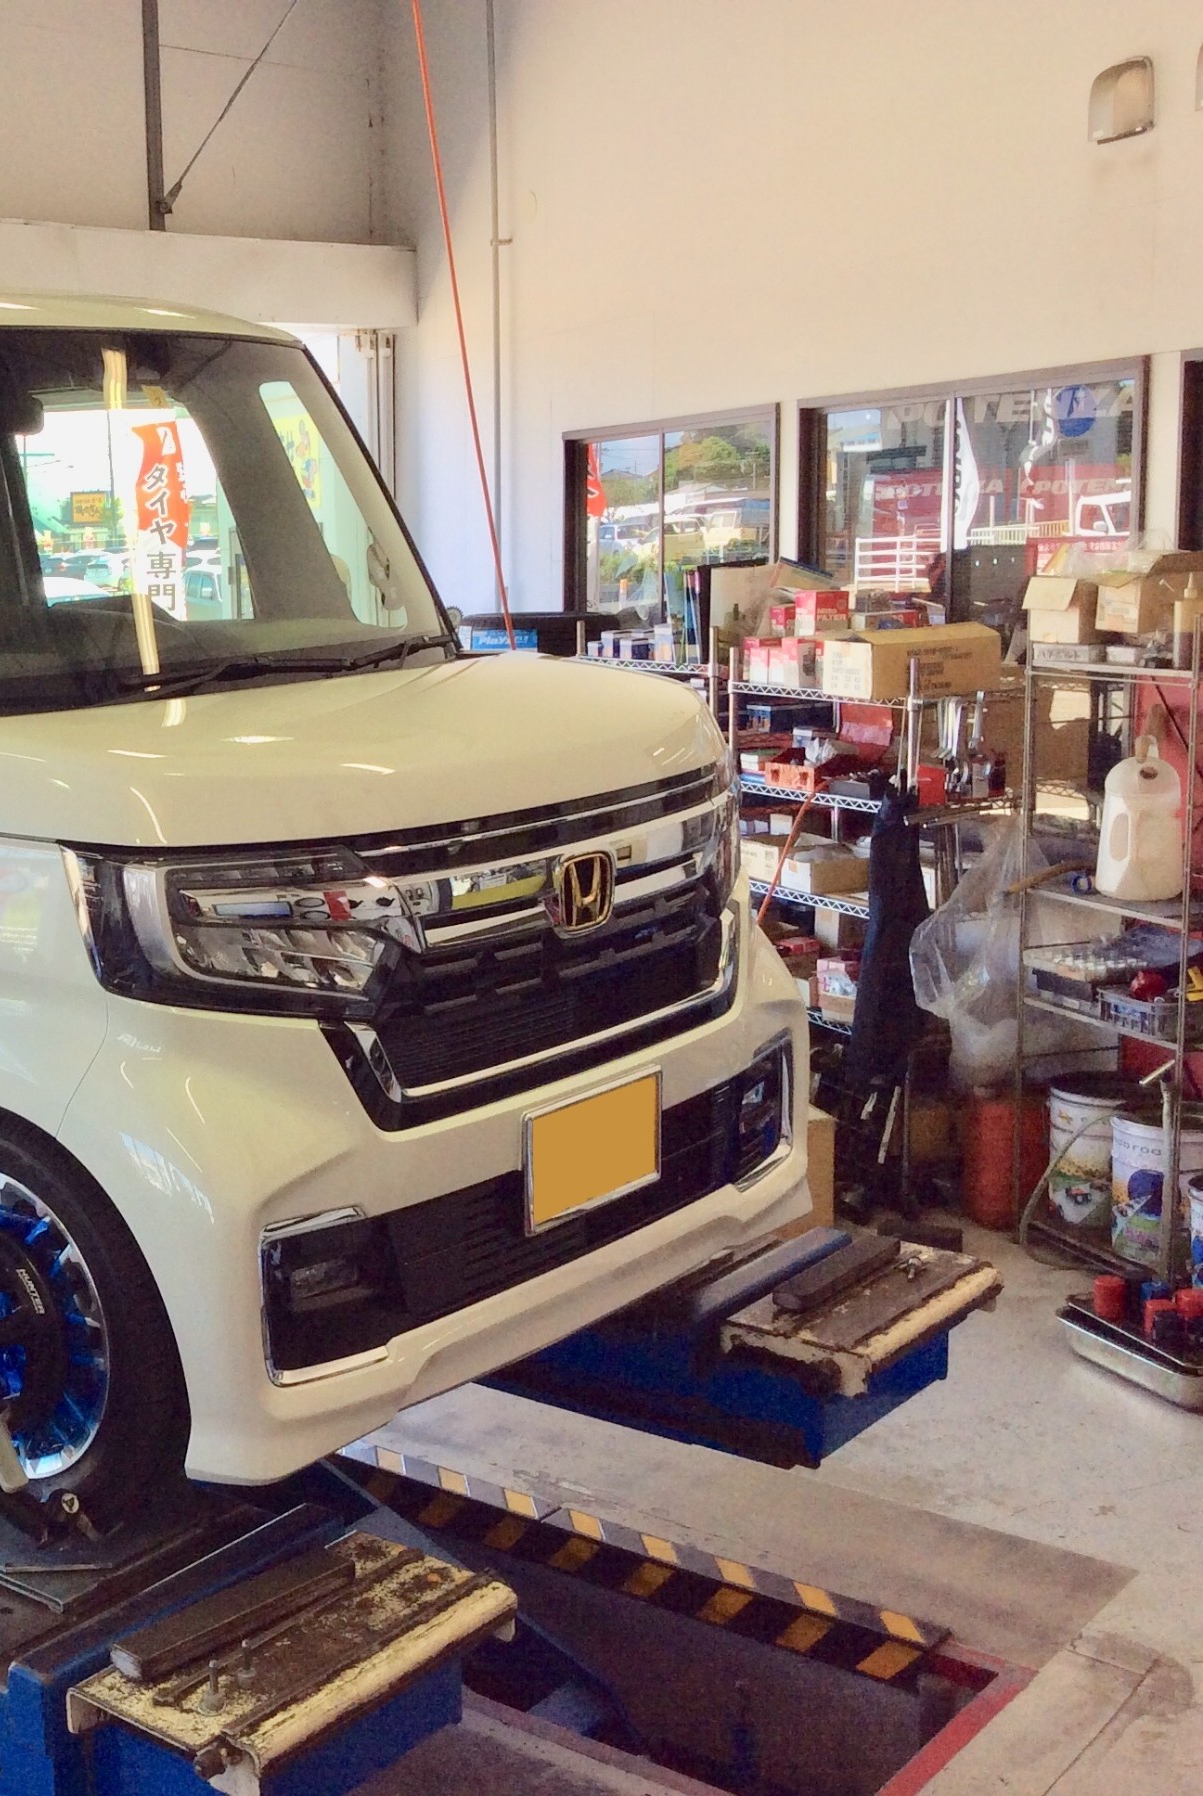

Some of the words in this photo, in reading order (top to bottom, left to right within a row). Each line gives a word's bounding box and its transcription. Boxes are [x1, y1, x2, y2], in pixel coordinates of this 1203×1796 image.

[143, 462, 177, 612] タイヤ専門
[15, 1269, 45, 1314] HUNTER
